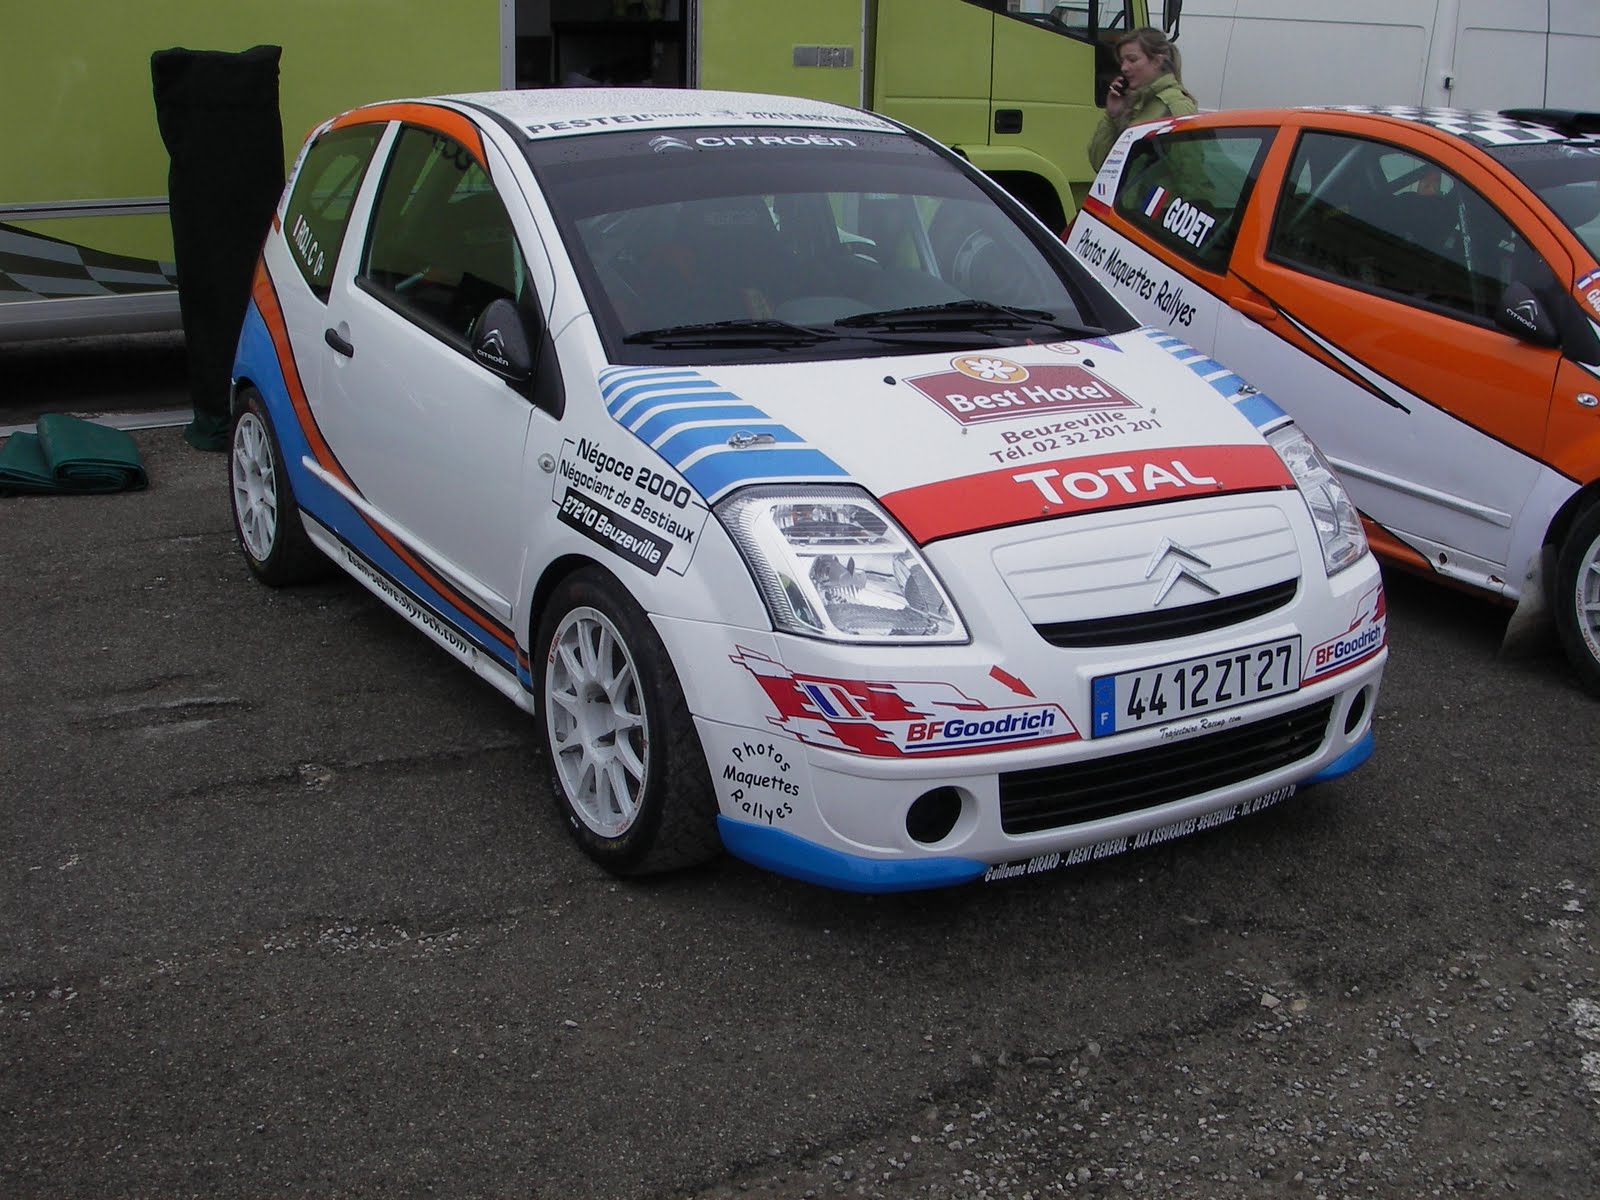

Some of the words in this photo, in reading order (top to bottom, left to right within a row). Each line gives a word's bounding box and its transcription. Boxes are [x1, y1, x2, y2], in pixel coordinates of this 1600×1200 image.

[526, 114, 654, 134] PESTEL
[1162, 197, 1216, 248] GODET
[1074, 227, 1106, 267] Photos
[1102, 247, 1156, 300] Maquettes
[1154, 279, 1196, 327] Rallyes
[945, 389, 1026, 412] Best
[1021, 381, 1112, 404] Hotel
[989, 445, 1033, 464] Tél.
[1033, 437, 1060, 453] 02
[1061, 431, 1089, 446] 32
[1089, 424, 1126, 440] 201
[1127, 418, 1163, 432] 201
[1001, 411, 1127, 445] Beuzeville
[576, 437, 634, 482] Négoce
[634, 467, 692, 509] 2000
[1011, 460, 1219, 505] TOTAL
[559, 459, 616, 501] Négociant
[614, 490, 633, 509] de
[630, 497, 695, 544] Bestiaux
[562, 495, 598, 527] 27210
[594, 514, 662, 565] Beuzeville
[1316, 625, 1381, 667] BFGoodrich
[906, 709, 1056, 743] BFGoodrich
[1100, 711, 1109, 726] F
[732, 741, 791, 772] Photos
[723, 764, 800, 796] Maquettes
[730, 788, 793, 825] Rallyes
[985, 862, 1026, 882] Guillaume
[1027, 853, 1060, 874] GIRARD
[1065, 845, 1094, 866] AGENT
[1093, 837, 1128, 860] GENERAL
[1133, 833, 1150, 850] AXA
[1149, 818, 1197, 845] ASSURANCES
